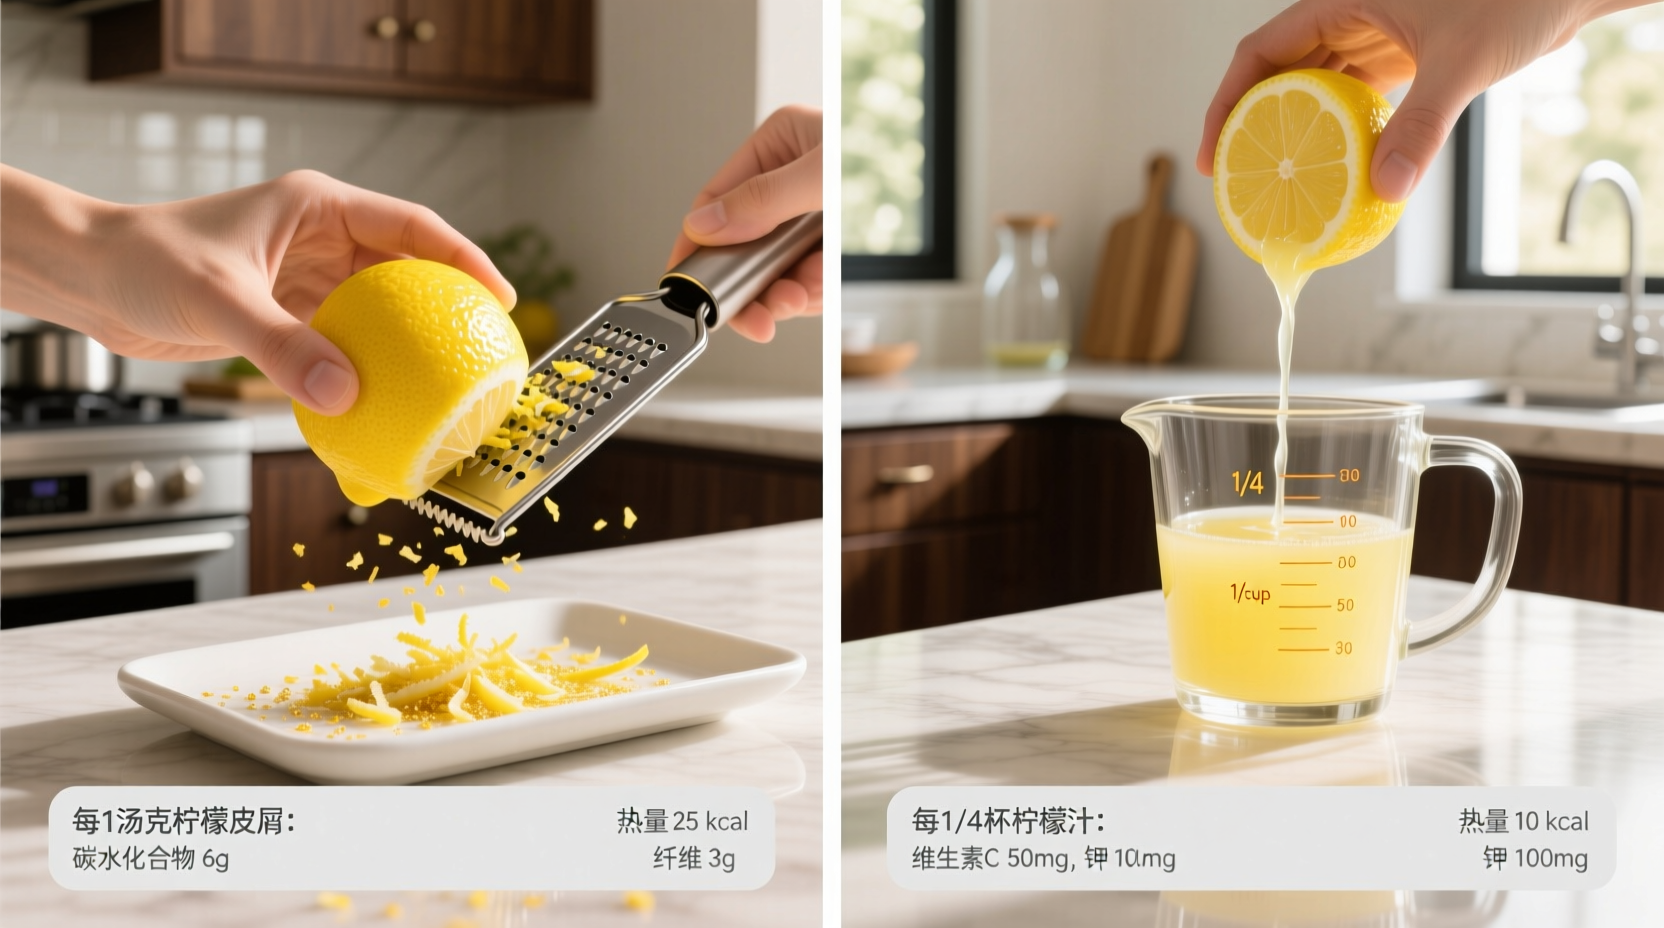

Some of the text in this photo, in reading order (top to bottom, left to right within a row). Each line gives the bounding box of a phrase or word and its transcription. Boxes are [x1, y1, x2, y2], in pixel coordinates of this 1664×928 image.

[1232, 470, 1264, 497] 1/4
[1230, 582, 1271, 605] 1/cup
[1337, 599, 1354, 612] 50
[1335, 641, 1353, 655] 30
